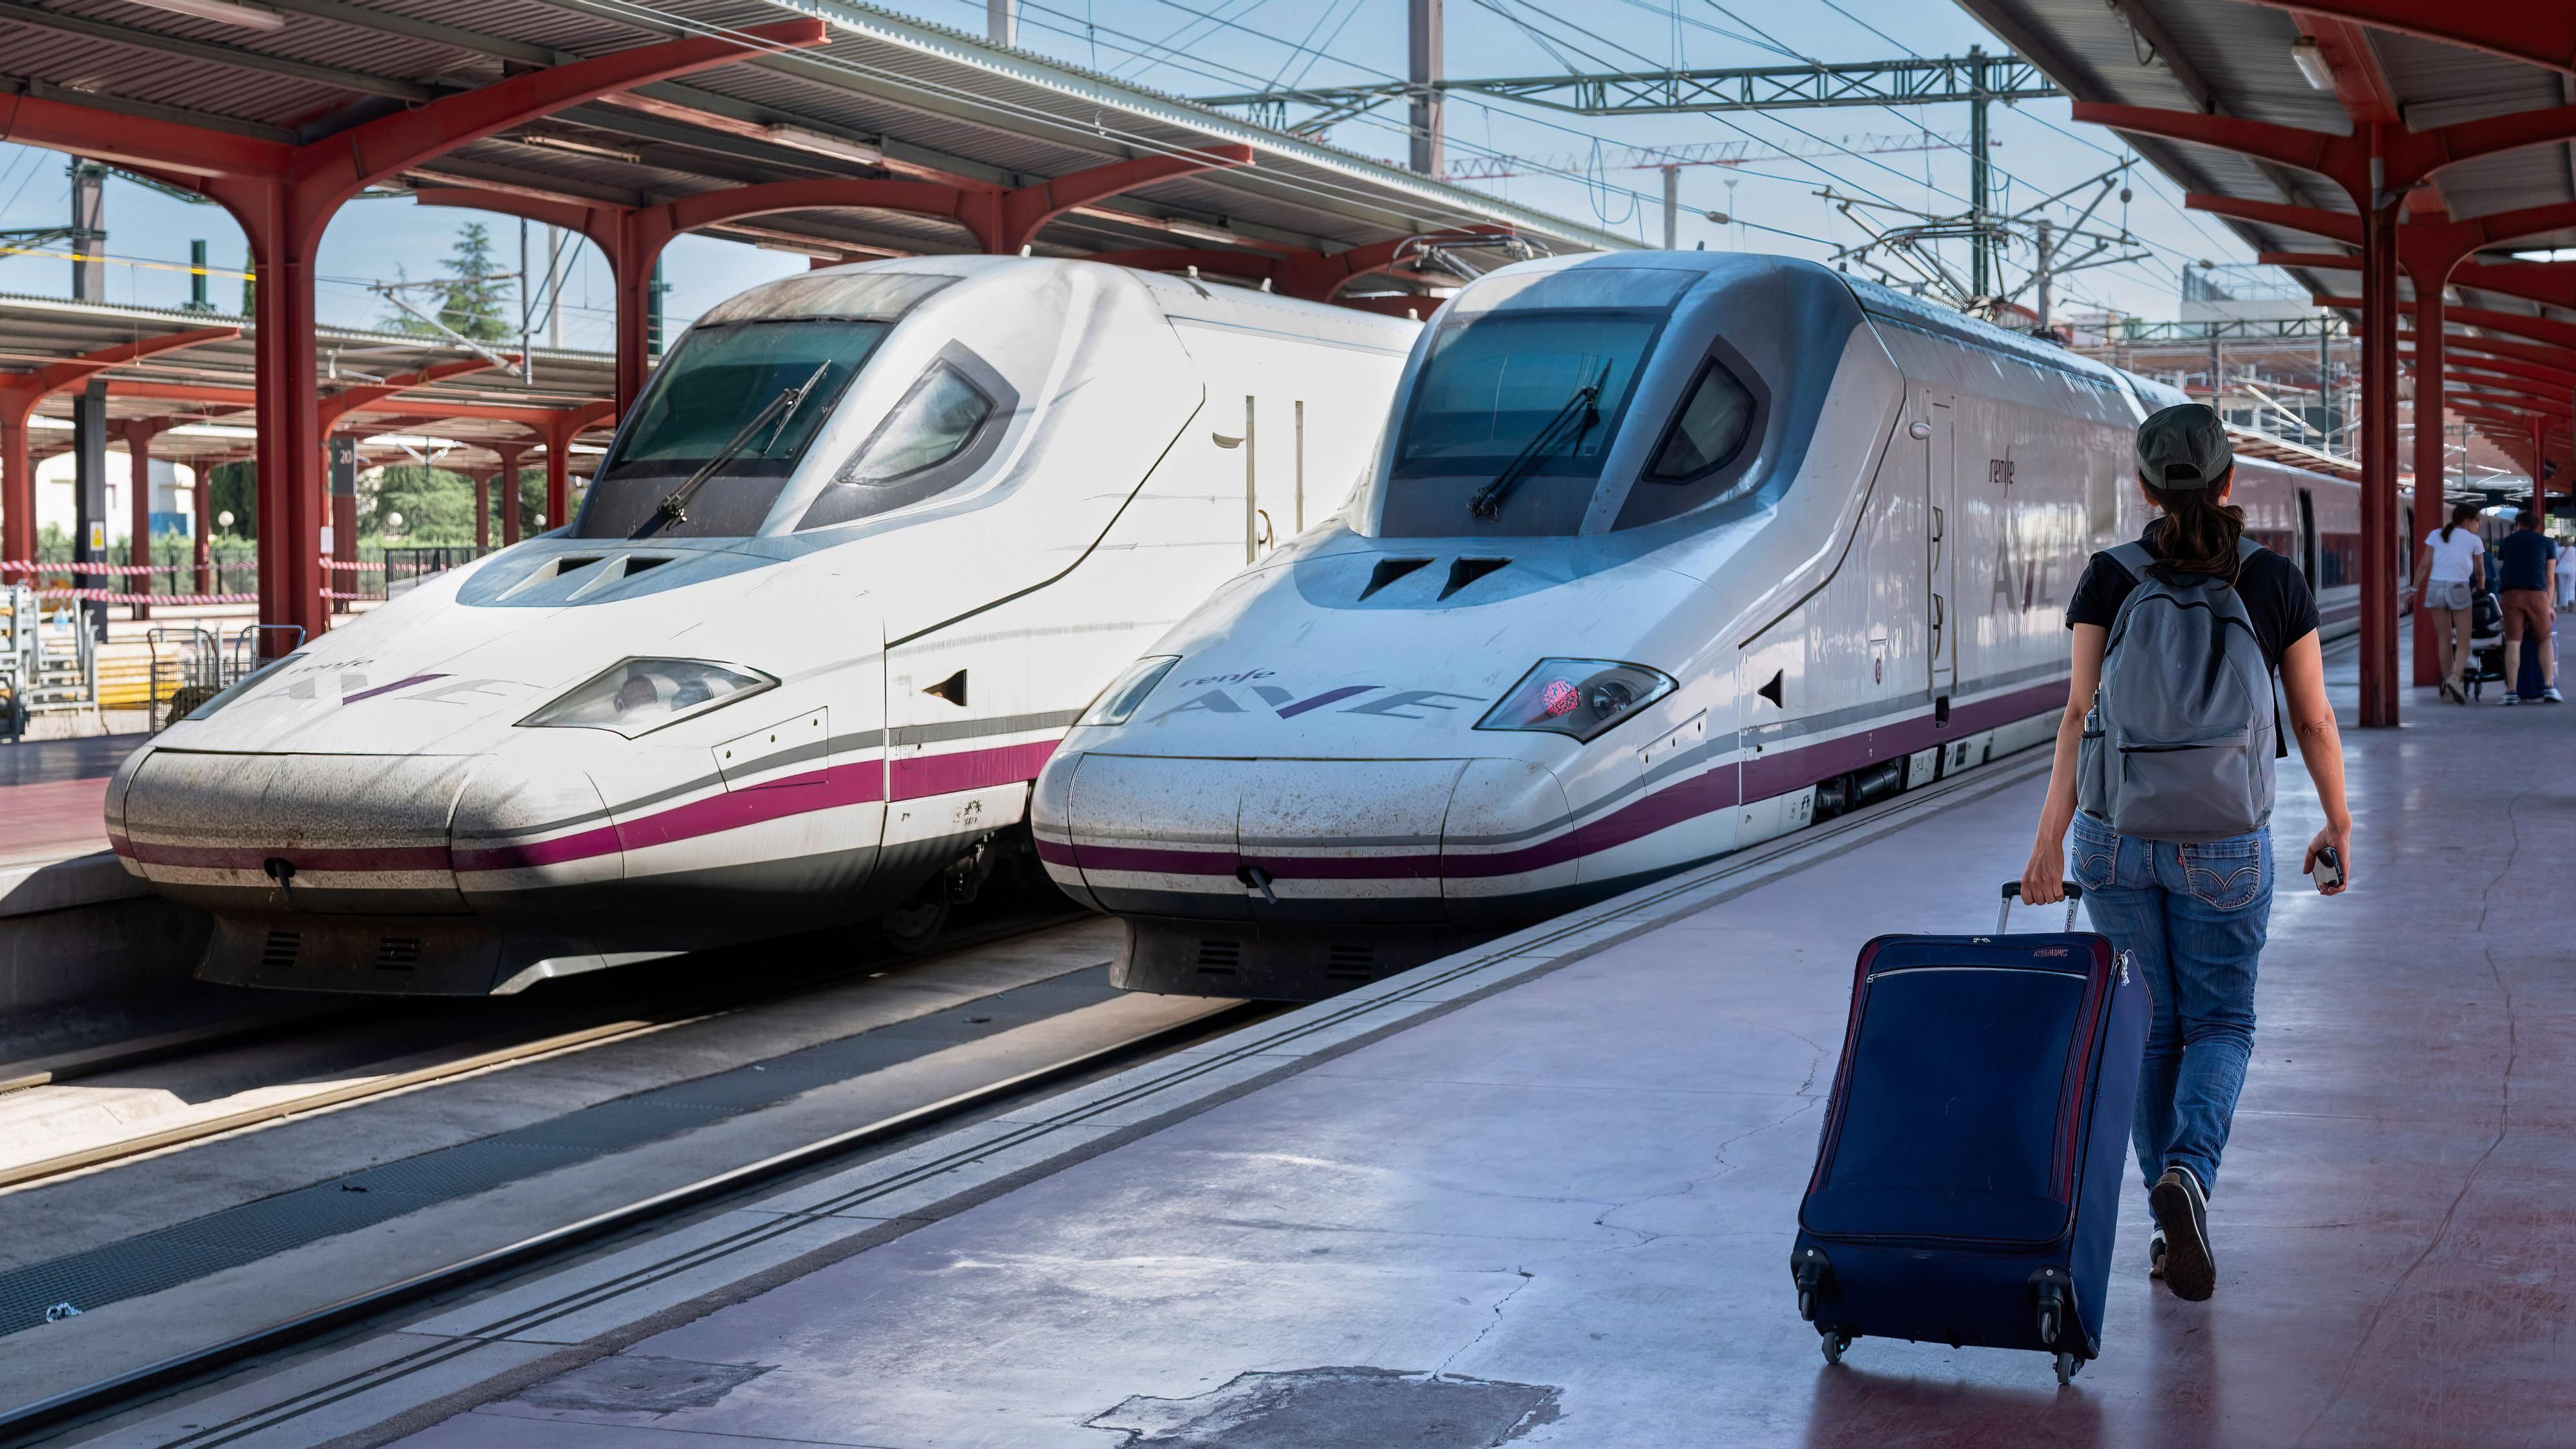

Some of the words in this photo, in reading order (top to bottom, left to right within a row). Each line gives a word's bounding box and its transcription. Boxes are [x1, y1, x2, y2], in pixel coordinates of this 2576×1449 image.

[339, 450, 353, 464] 20
[1179, 667, 1276, 688] renfe
[1142, 685, 1489, 724] AVE
